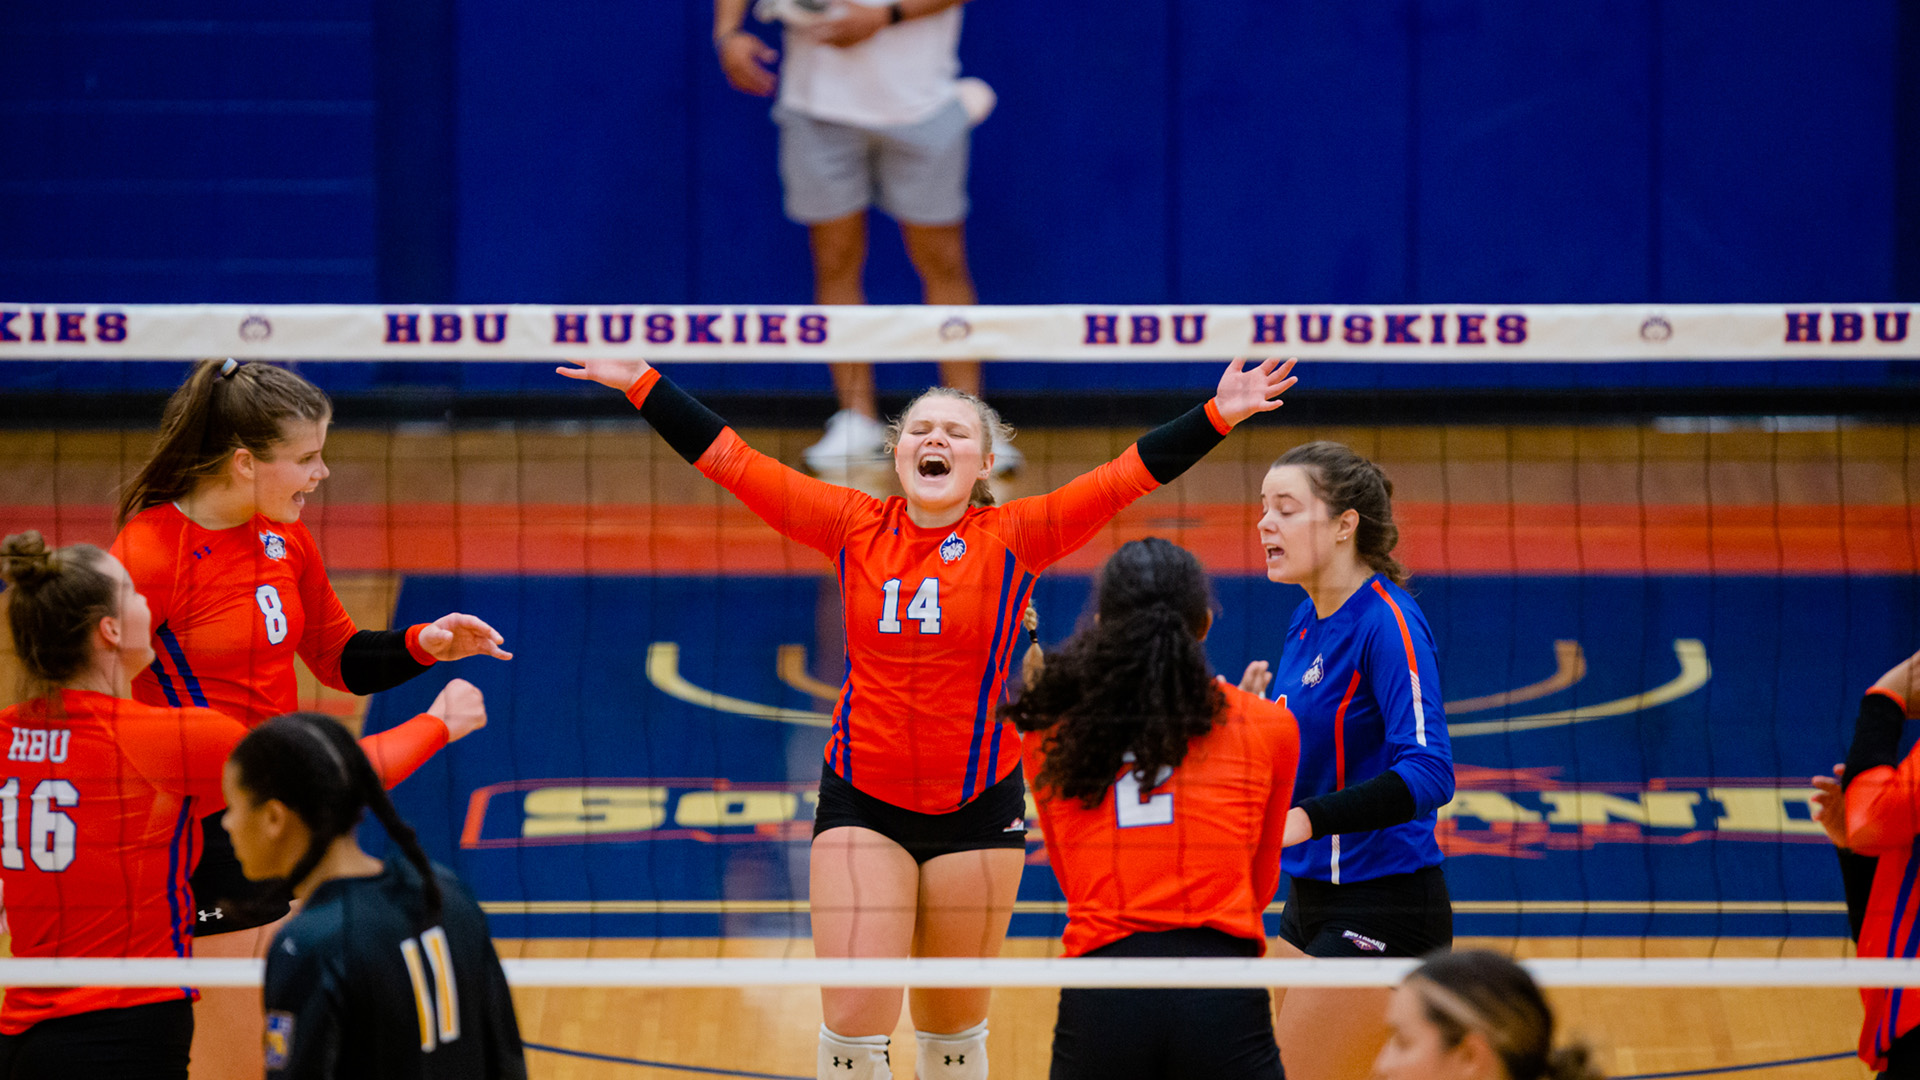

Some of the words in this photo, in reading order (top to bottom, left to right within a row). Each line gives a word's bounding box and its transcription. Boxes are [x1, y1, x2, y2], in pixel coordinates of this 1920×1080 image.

[0, 311, 128, 343] KIES
[383, 311, 509, 344] HBU
[552, 311, 830, 344] HUSKIES
[1082, 311, 1208, 345] HBU
[1251, 311, 1530, 345] HUSKIES
[1784, 310, 1911, 343] HBU
[255, 584, 289, 646] 8
[878, 577, 942, 635] 14
[7, 727, 71, 763] HBU
[1114, 750, 1175, 829] 2
[0, 777, 80, 872] 16
[400, 925, 461, 1053] 11
